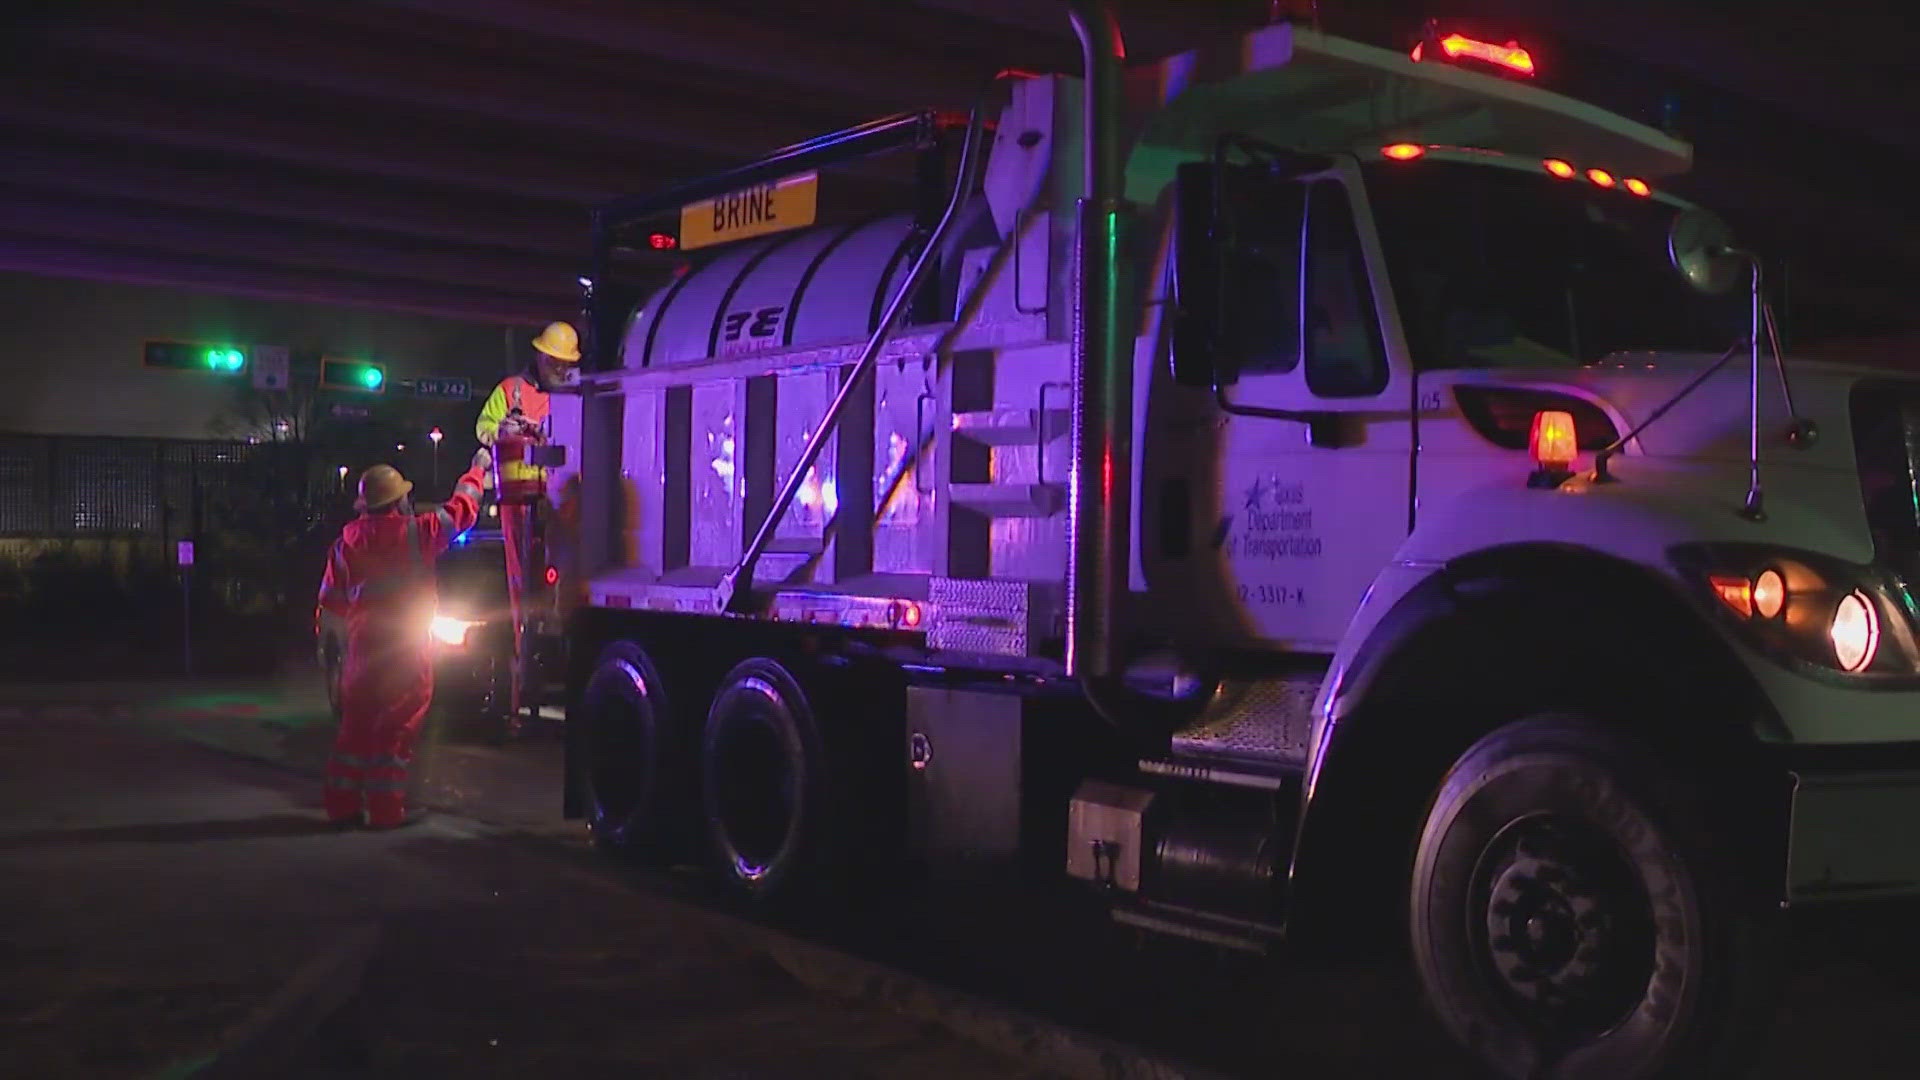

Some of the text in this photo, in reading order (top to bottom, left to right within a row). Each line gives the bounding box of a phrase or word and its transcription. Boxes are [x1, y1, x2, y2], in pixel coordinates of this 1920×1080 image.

[712, 186, 776, 232] BRINE
[420, 381, 466, 395] SH 242
[1247, 507, 1313, 532] Department
[1243, 534, 1322, 560] Transportation
